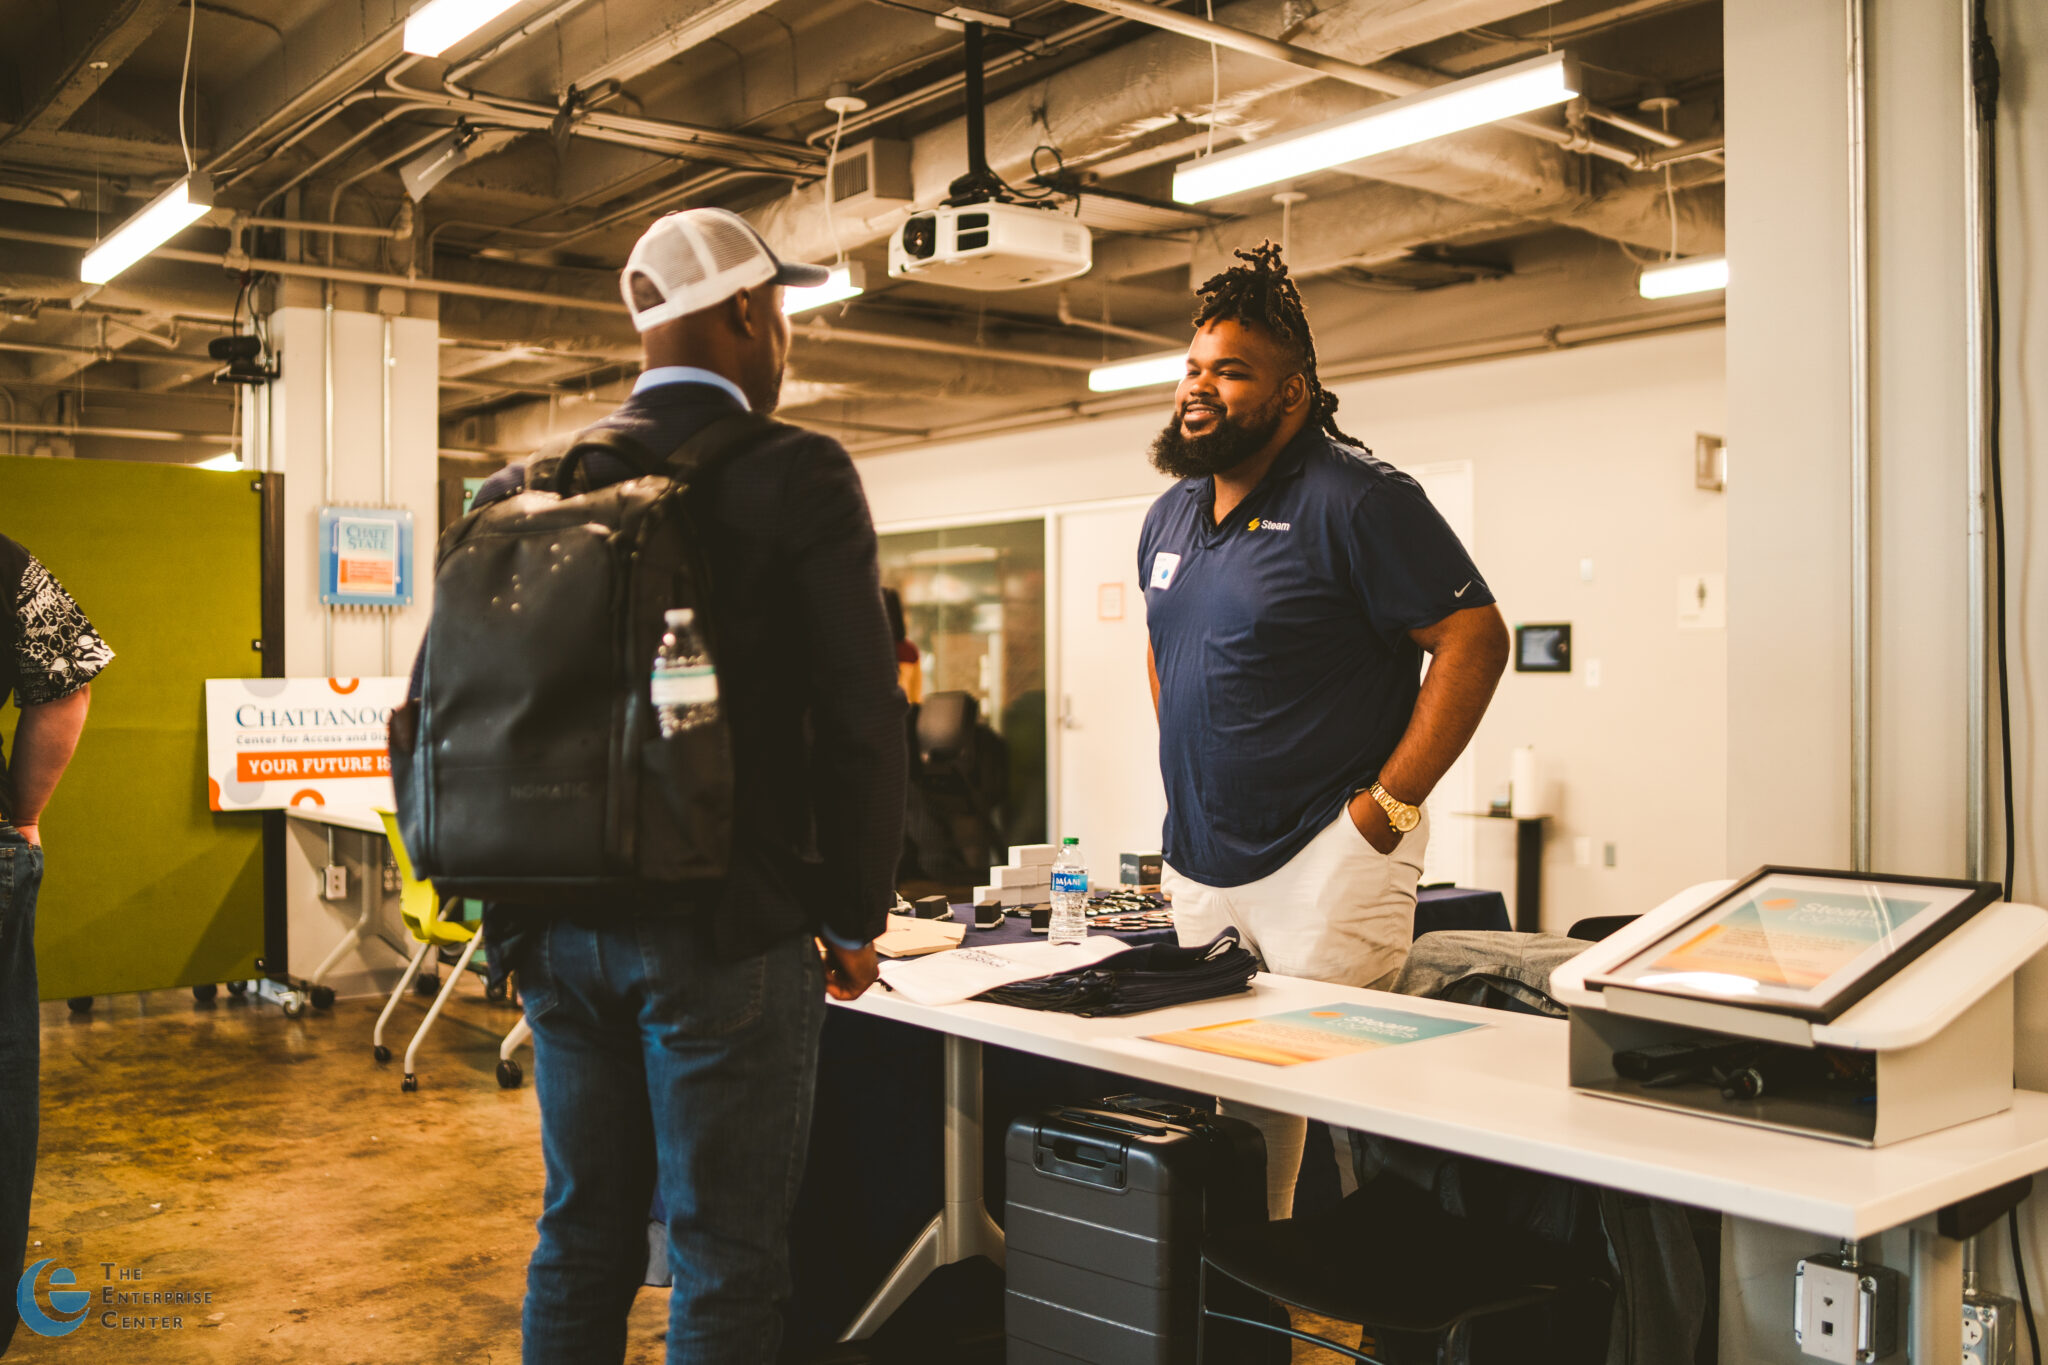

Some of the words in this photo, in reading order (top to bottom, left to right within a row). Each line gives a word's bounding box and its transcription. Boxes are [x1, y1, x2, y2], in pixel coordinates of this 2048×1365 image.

[1260, 519, 1291, 531] Steam
[236, 734, 276, 745] Center
[281, 733, 298, 744] for
[302, 732, 342, 743] Access
[345, 732, 367, 742] and
[249, 758, 298, 775] YOUR
[302, 756, 372, 773] FUTURE
[376, 756, 391, 771] IS
[1055, 876, 1080, 887] DASANI
